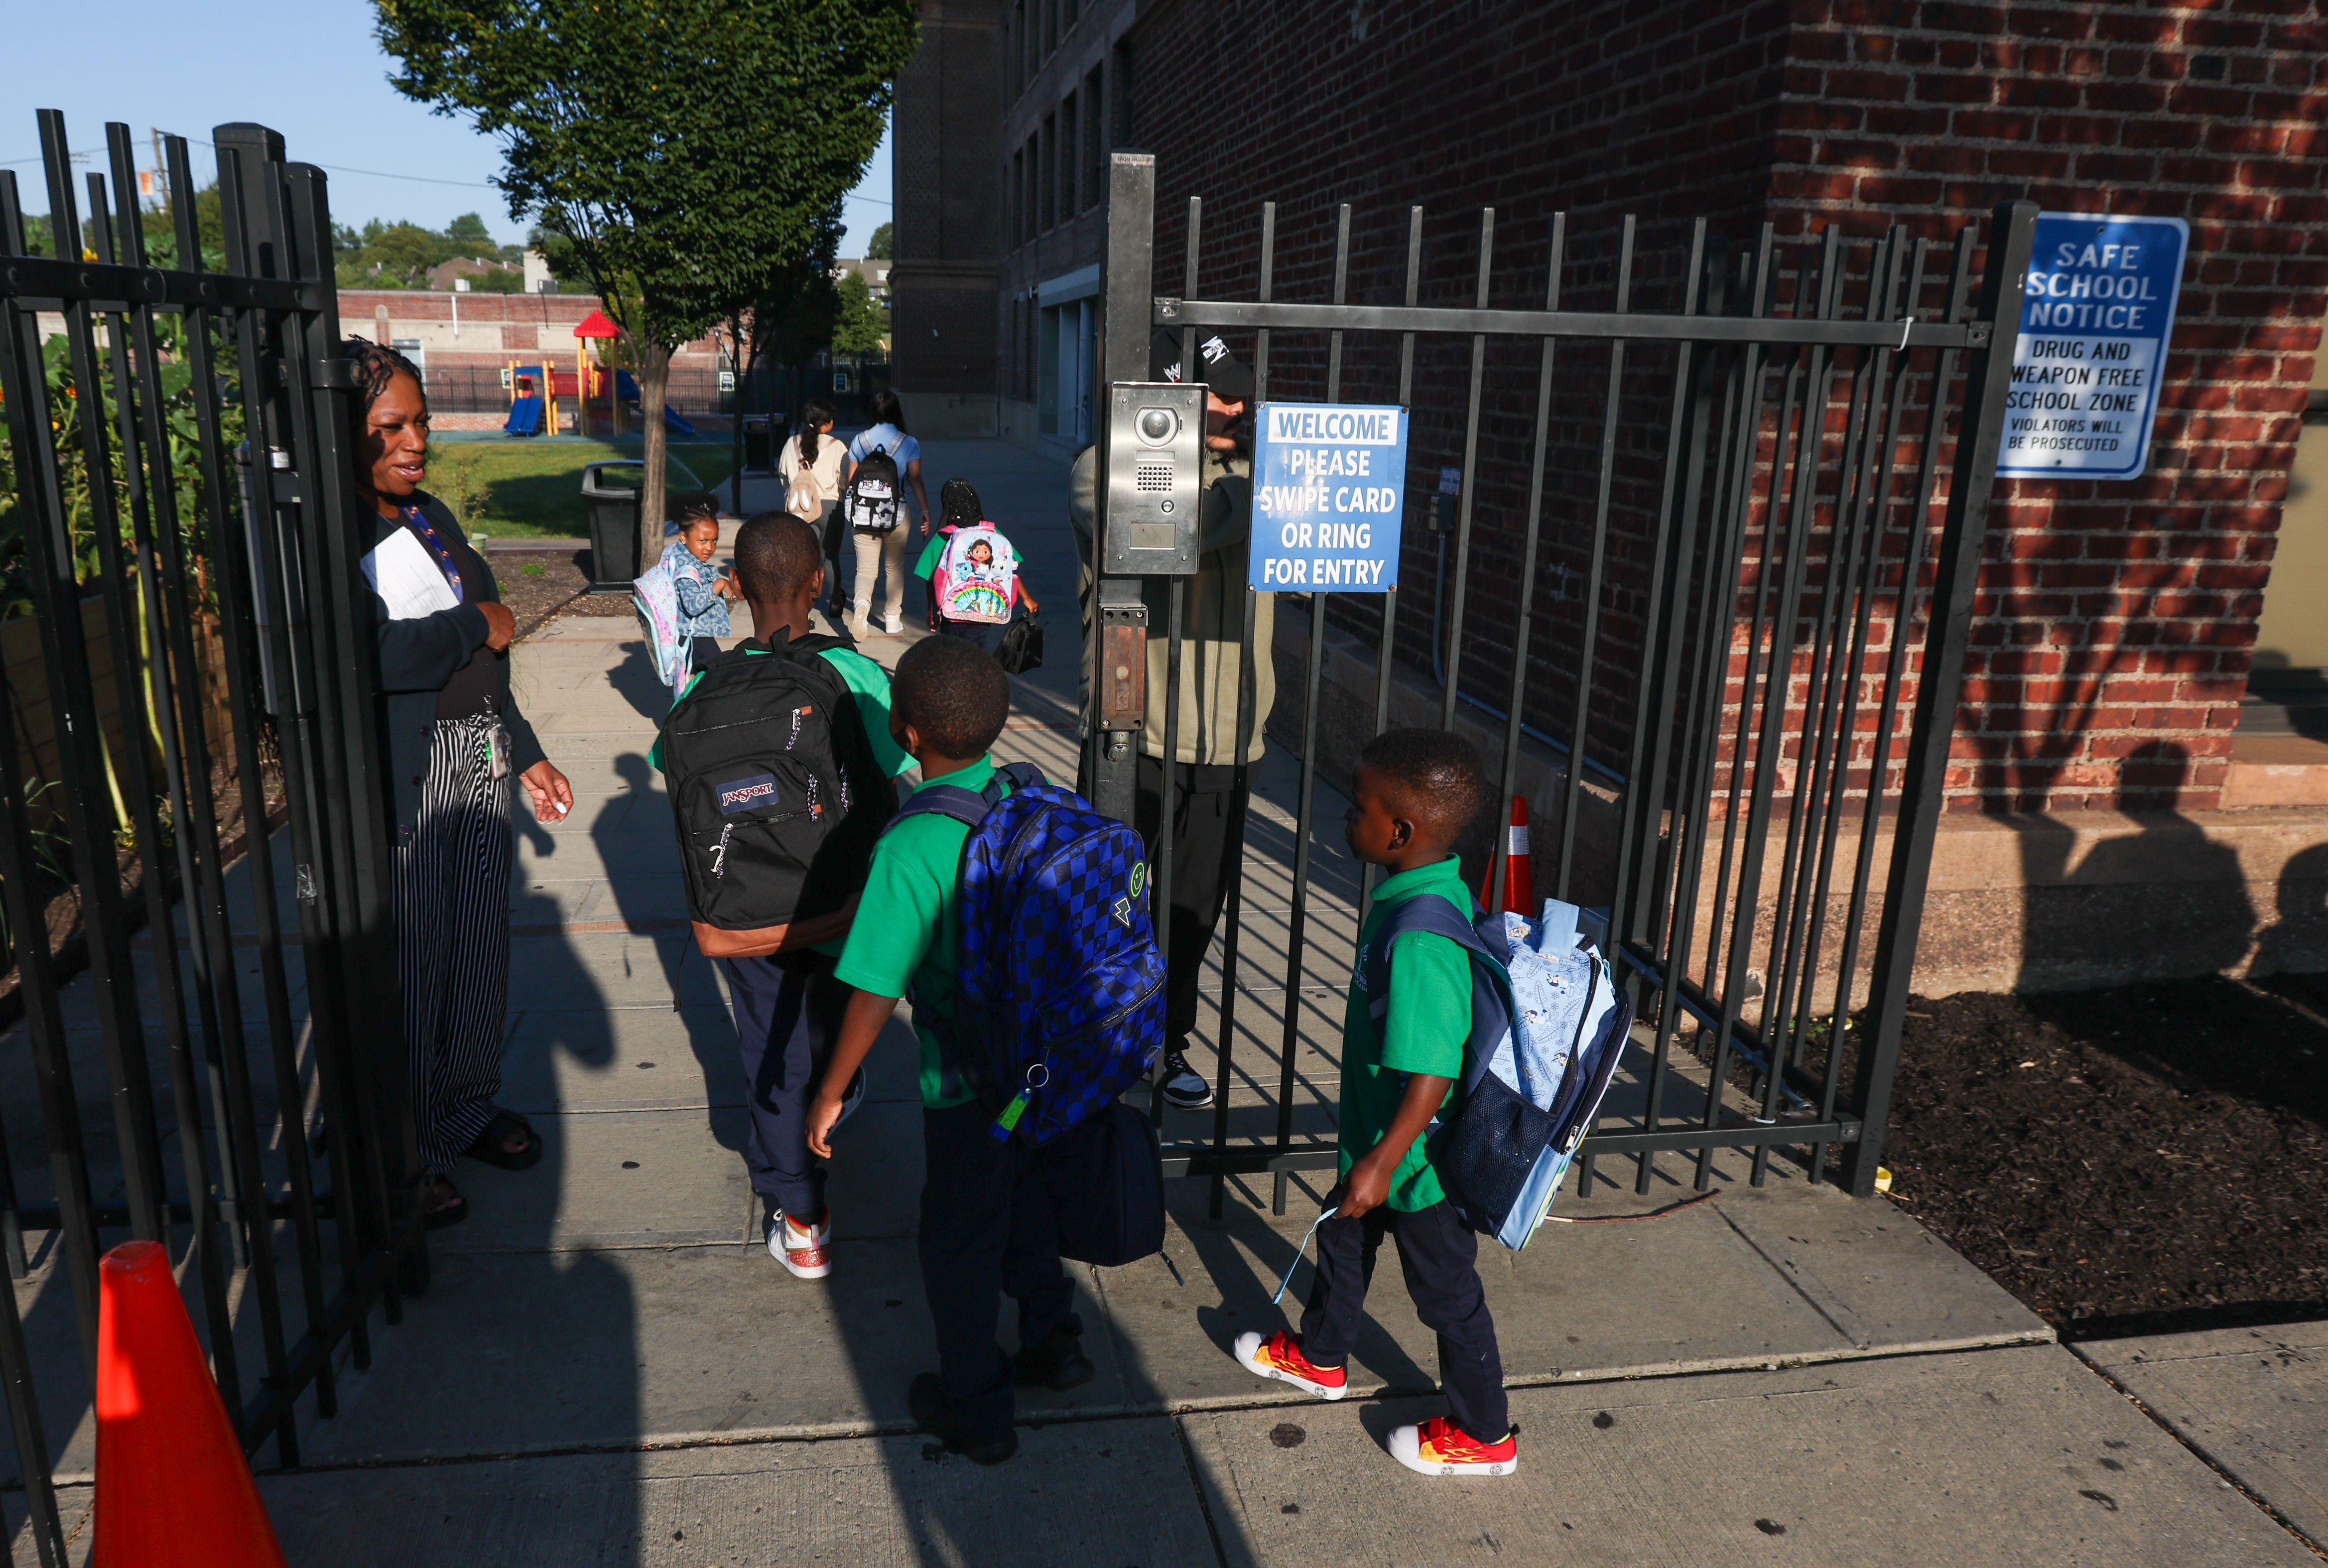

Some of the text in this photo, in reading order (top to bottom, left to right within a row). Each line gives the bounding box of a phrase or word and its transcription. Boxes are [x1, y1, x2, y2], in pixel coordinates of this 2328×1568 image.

[2056, 243, 2140, 269] SAFE
[2026, 272, 2157, 300] SCHOOL
[2029, 302, 2147, 330] NOTICE
[2032, 340, 2130, 361] DRUG AND
[2010, 365, 2144, 387] WEAPON FREE
[2006, 391, 2138, 412] SCHOOL ZONE
[1278, 412, 1389, 440] WELCOME
[2011, 418, 2123, 433] VIOLATORS WILL
[2008, 436, 2119, 451] BE PROSECUTED
[1291, 449, 1371, 476] PLEASE
[1260, 486, 1396, 513] SWIPE CARD
[1281, 523, 1371, 549] OR RING
[1264, 558, 1385, 584] FOR ENTRY
[722, 783, 773, 806] JANSPORT
